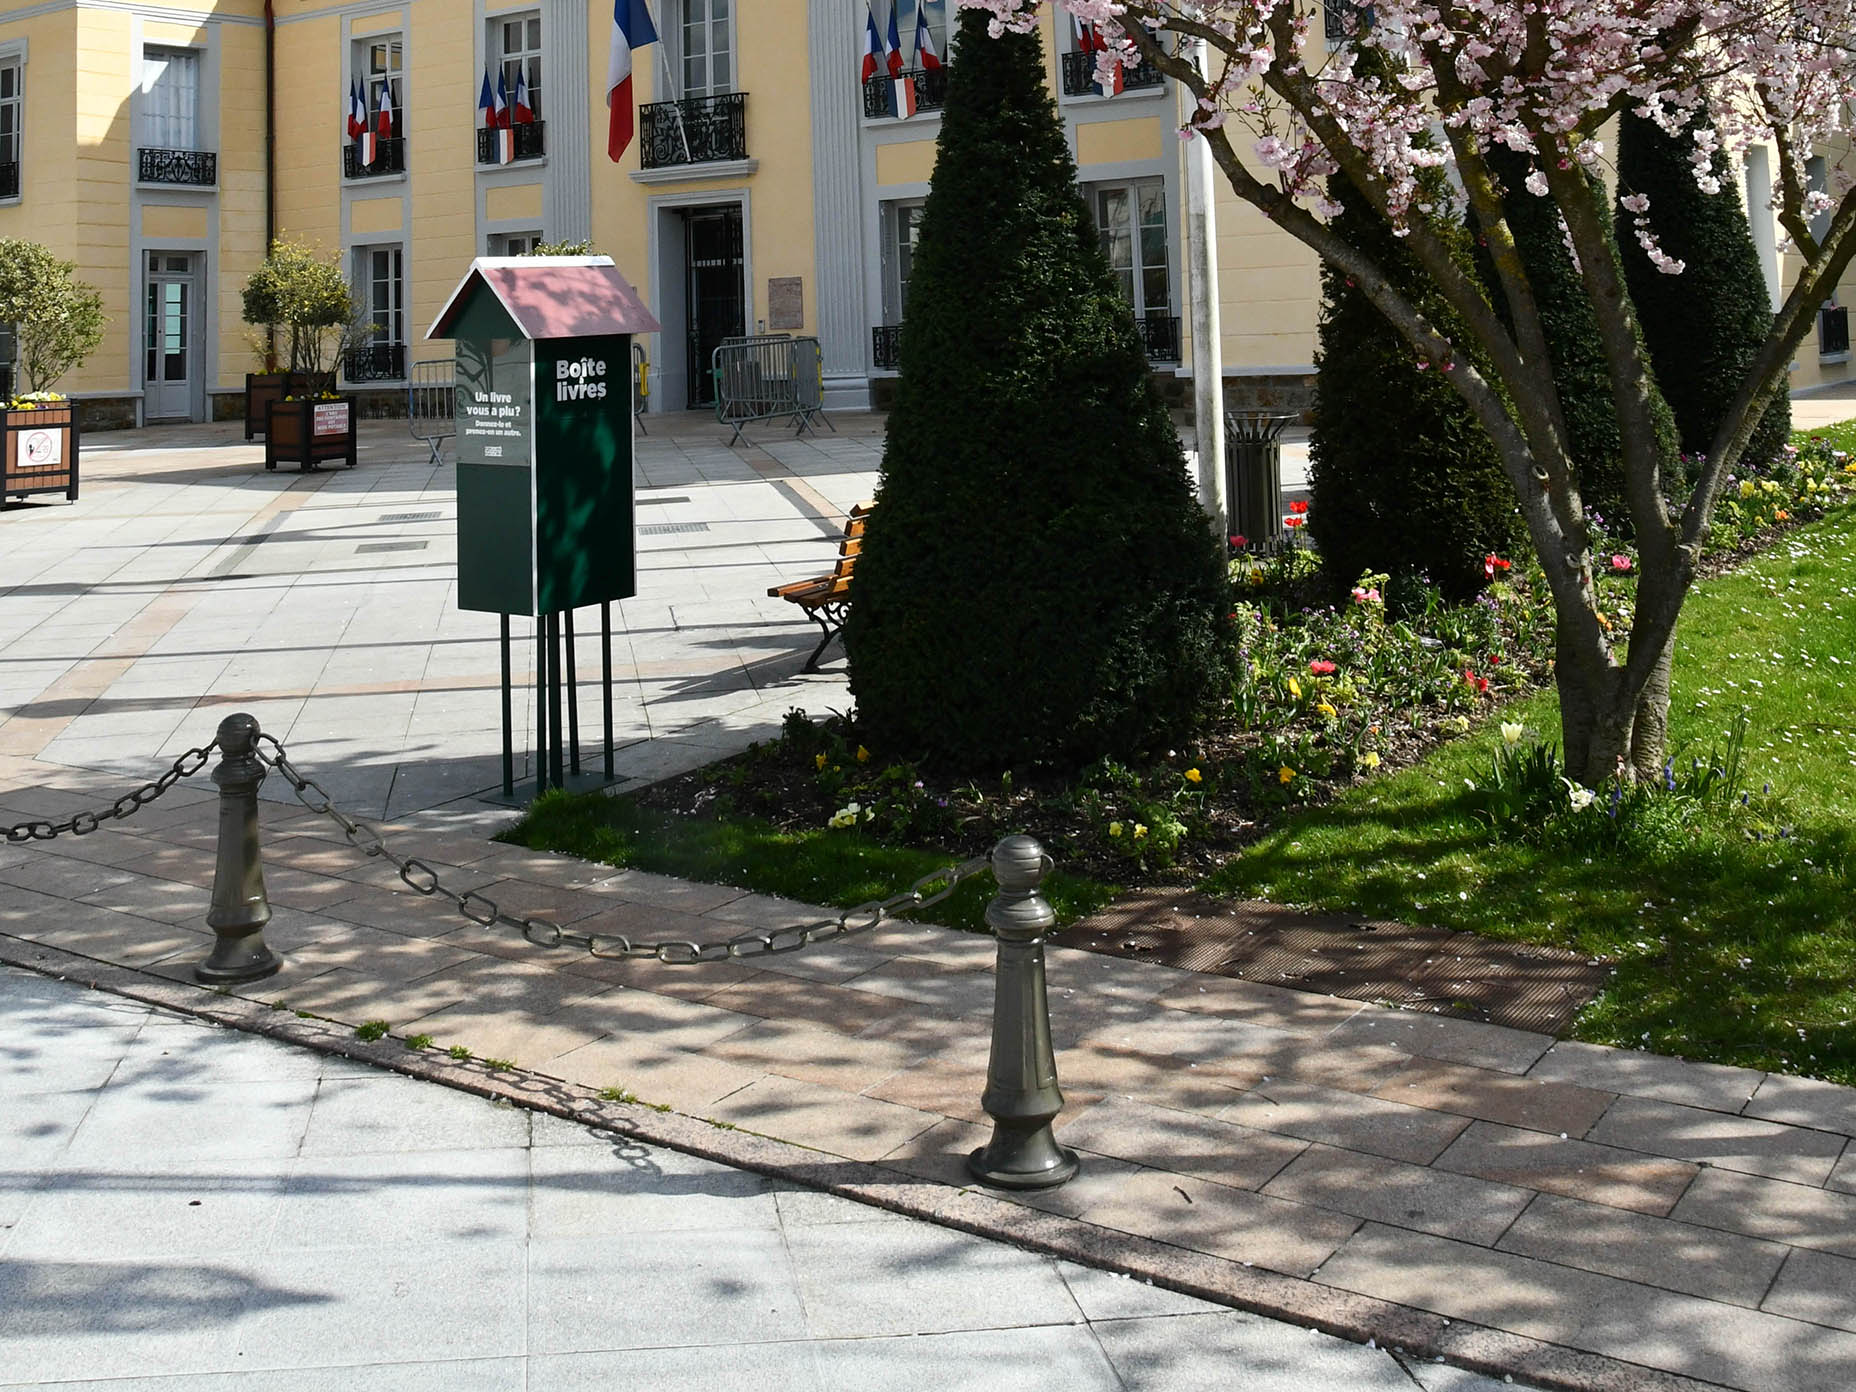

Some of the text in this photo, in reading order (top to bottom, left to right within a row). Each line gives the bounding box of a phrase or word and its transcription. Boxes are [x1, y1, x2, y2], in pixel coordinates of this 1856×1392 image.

[556, 356, 607, 379] Boîte
[474, 391, 512, 403] Un livre
[556, 381, 607, 401] livres
[466, 406, 490, 416] vous
[491, 407, 497, 416] a
